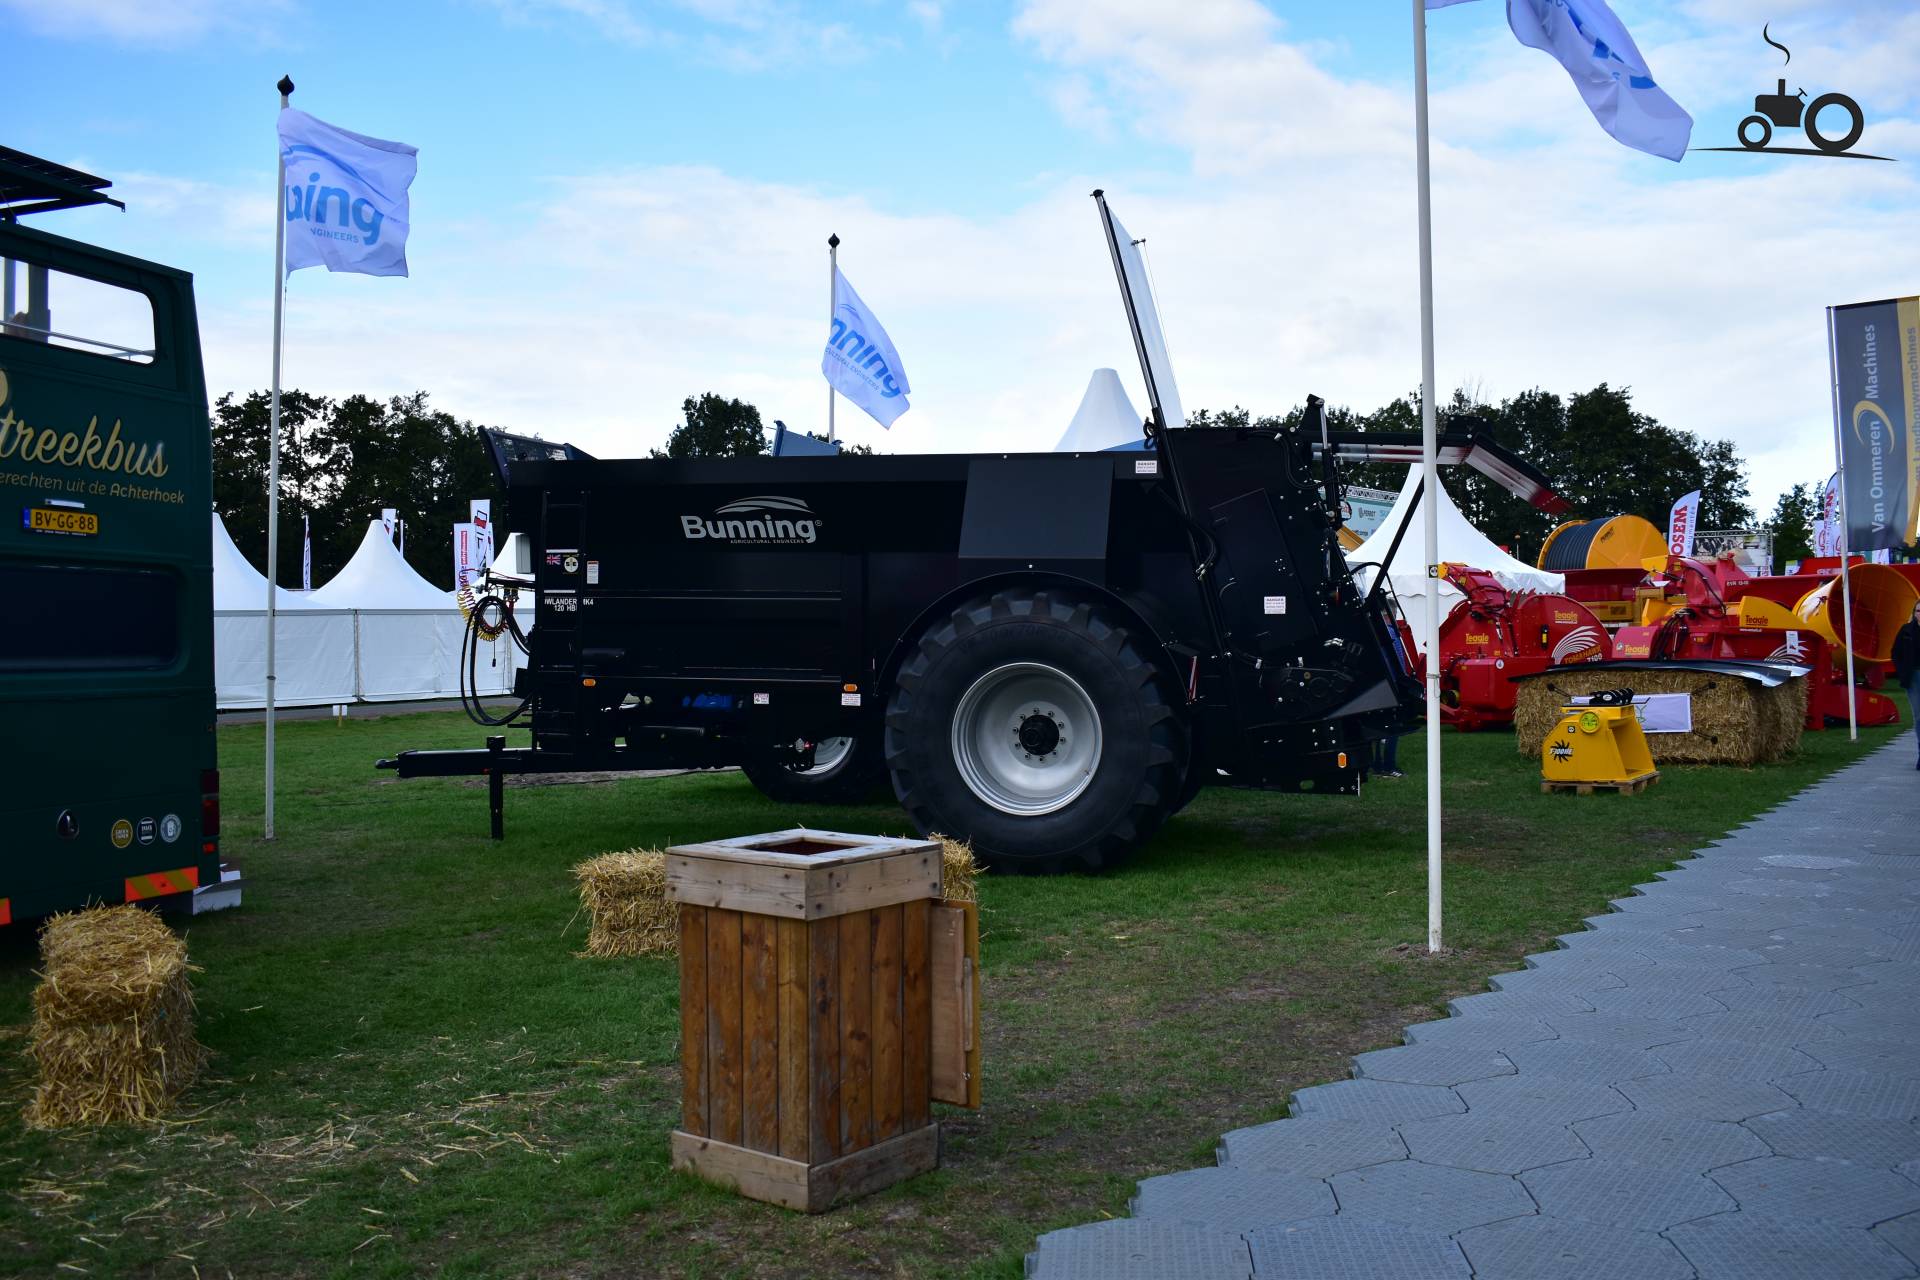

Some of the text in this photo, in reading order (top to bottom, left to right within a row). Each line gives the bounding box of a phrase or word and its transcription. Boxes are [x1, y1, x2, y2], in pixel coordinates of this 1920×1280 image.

[0, 370, 169, 478] treekbus
[1864, 324, 1885, 533] Van Ommeren Machines
[66, 478, 87, 493] uit
[88, 480, 106, 495] de
[109, 483, 185, 504] Achterhoek
[35, 511, 95, 530] BV-GG-88
[680, 514, 817, 544] Bunning
[1554, 610, 1578, 620] Teagle
[1745, 614, 1769, 625] Teagle
[1466, 633, 1489, 642] Teagle
[1624, 644, 1649, 654] Teagle
